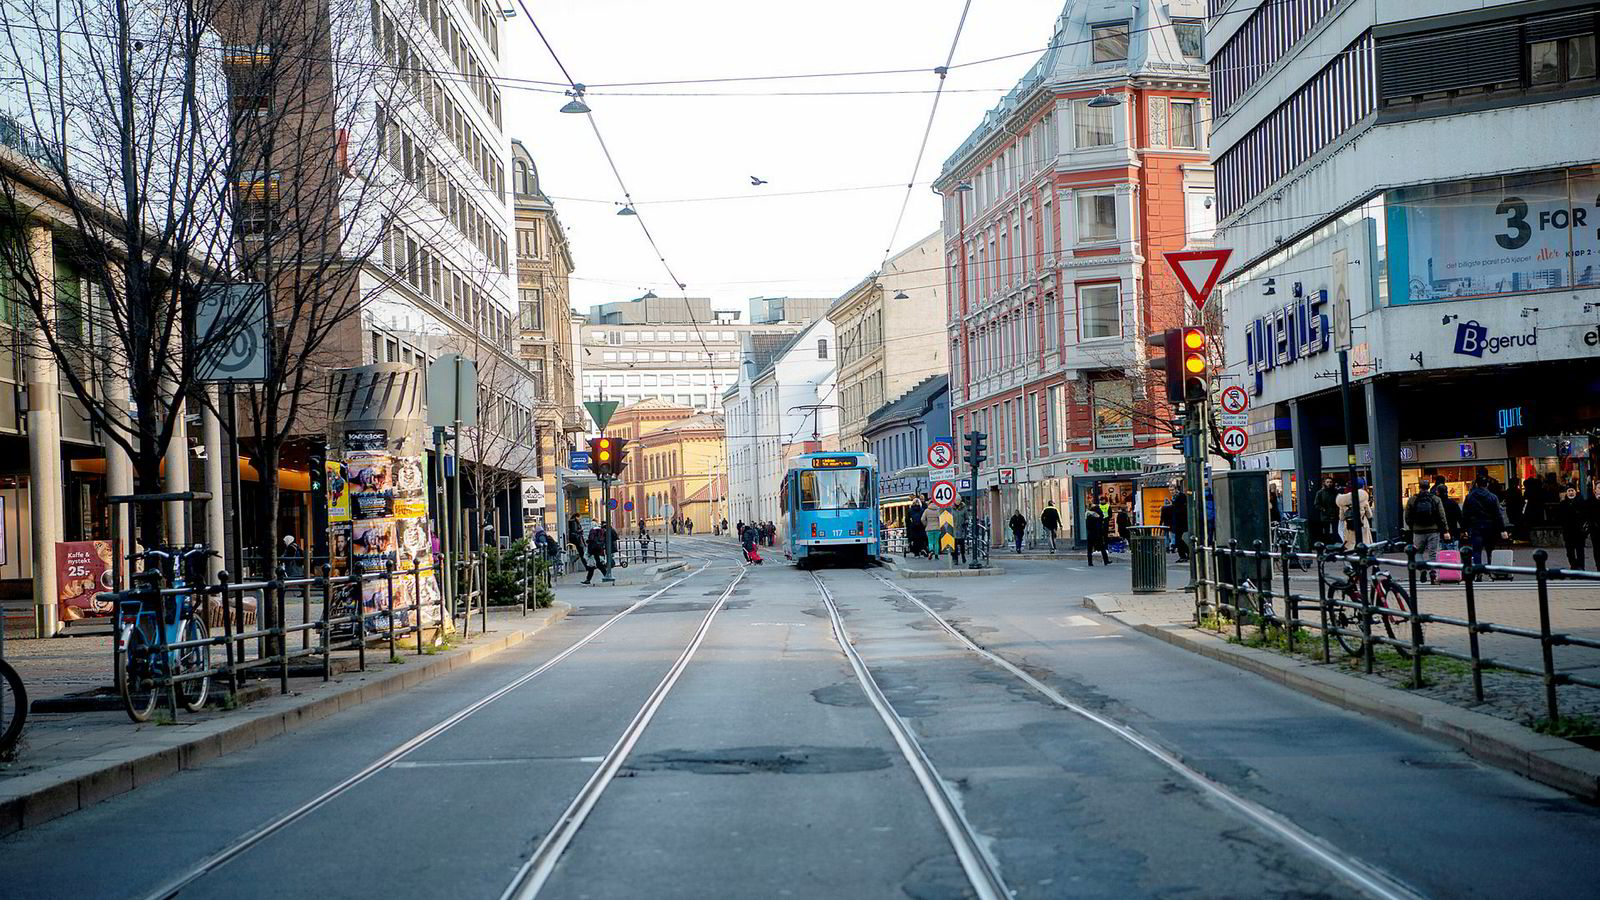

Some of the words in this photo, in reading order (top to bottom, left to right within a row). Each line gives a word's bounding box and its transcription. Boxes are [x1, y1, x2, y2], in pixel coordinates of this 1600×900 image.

[1495, 197, 1532, 250] 3
[1539, 208, 1587, 230] FOR
[1462, 327, 1537, 354] Bogerud
[1226, 433, 1244, 447] 40
[935, 487, 952, 500] 40
